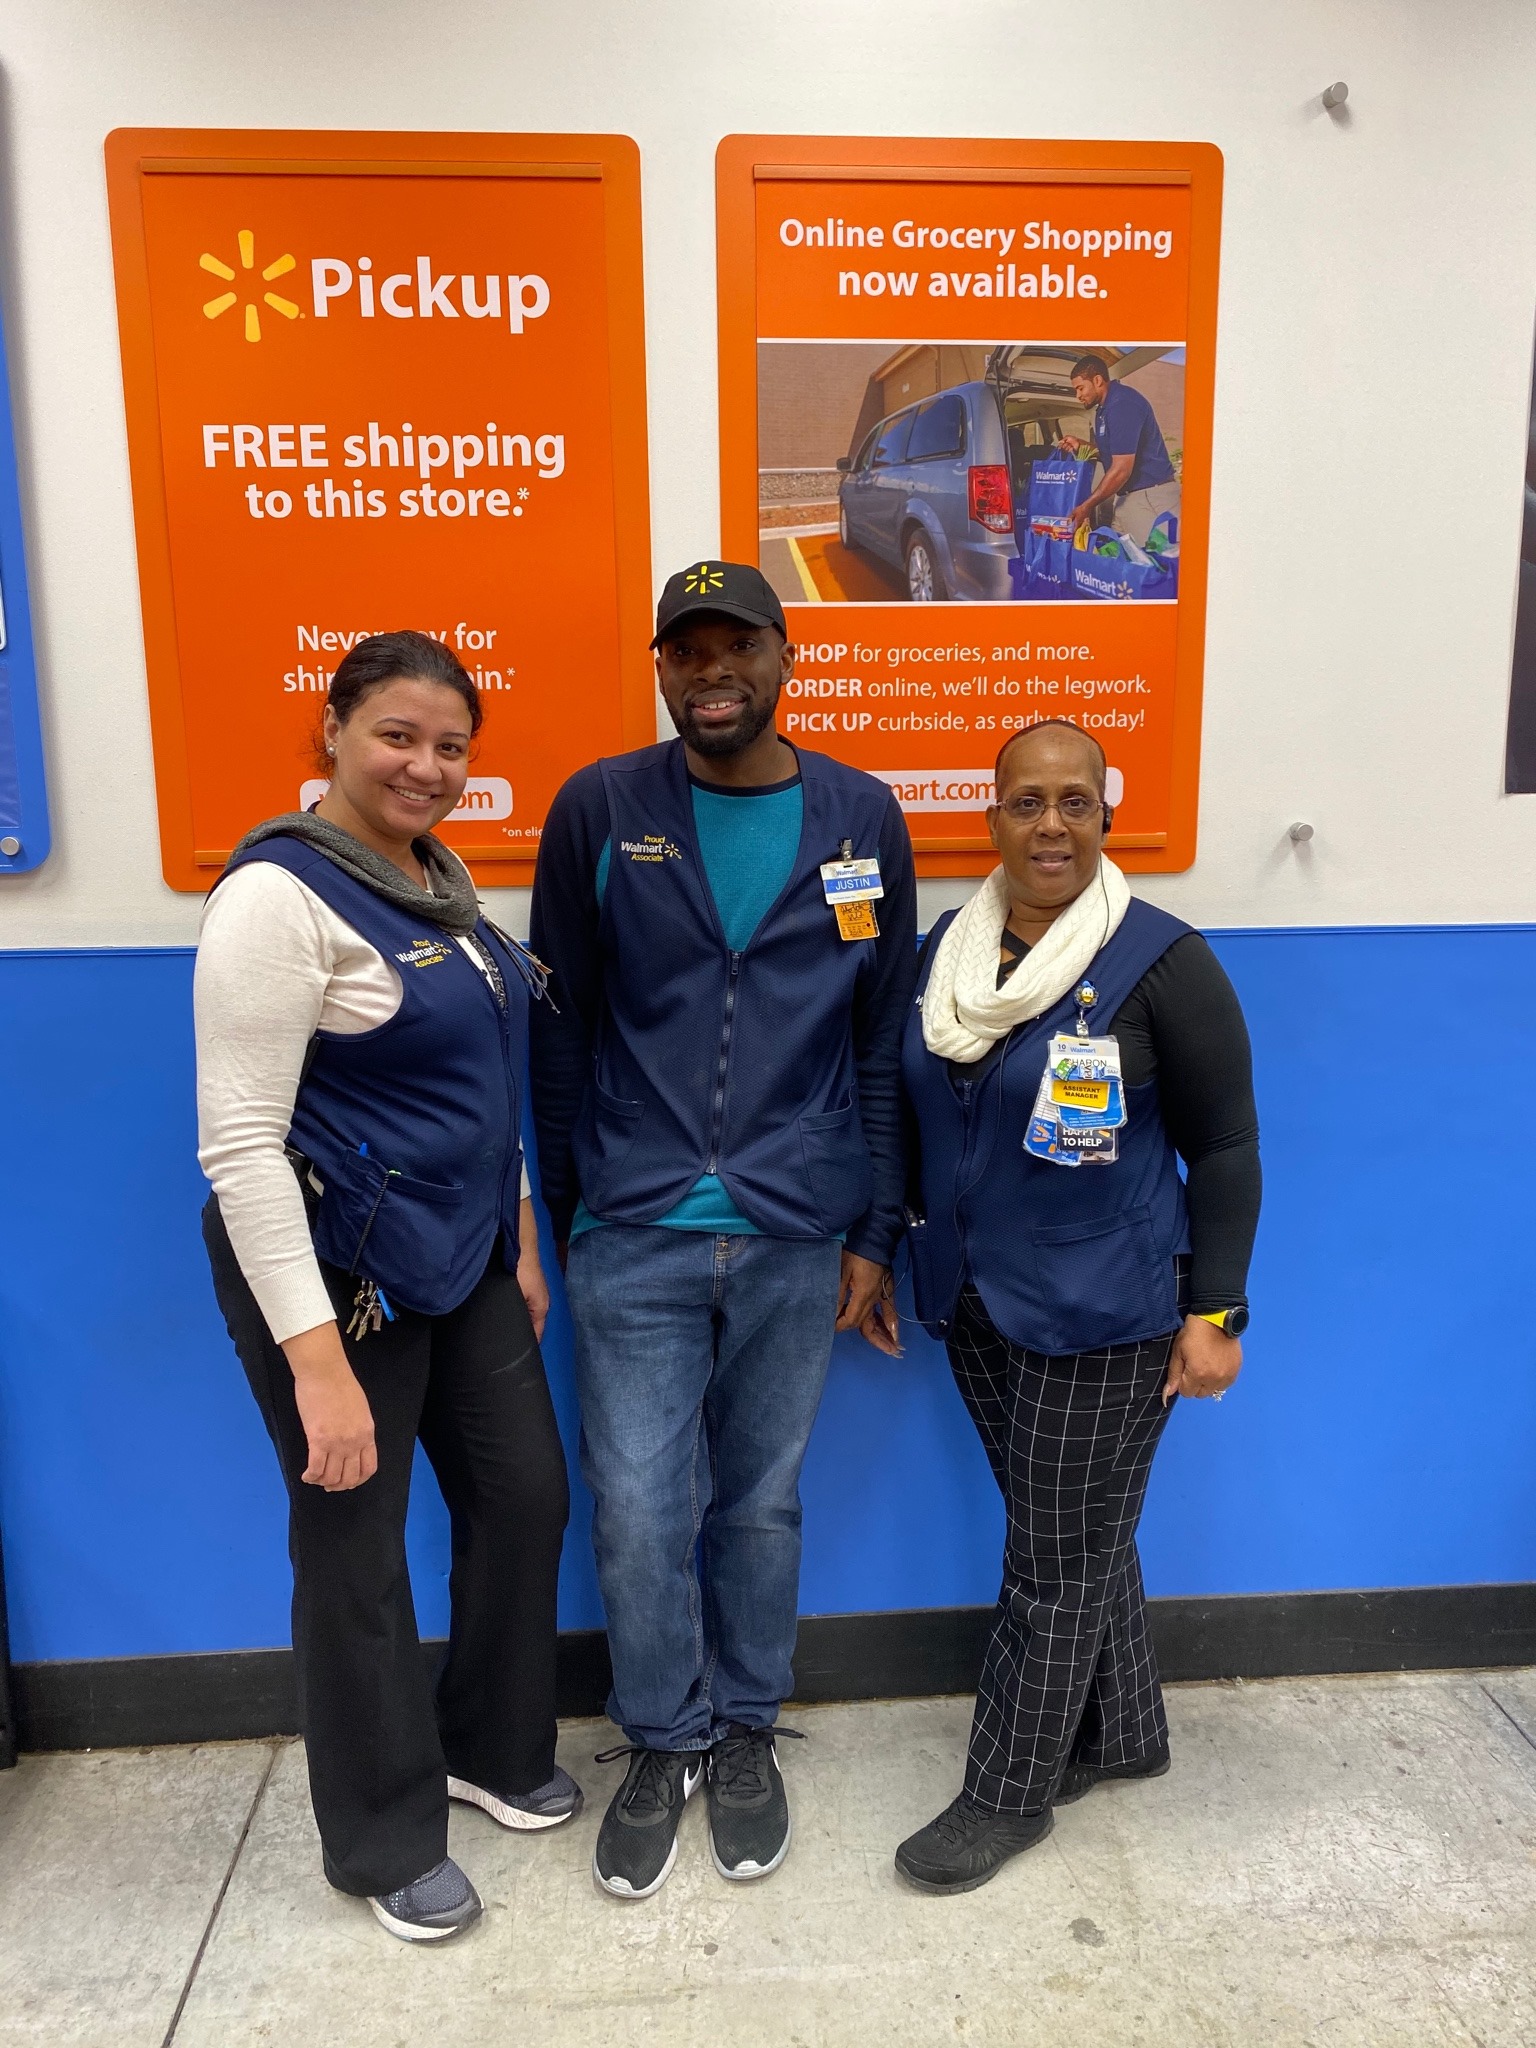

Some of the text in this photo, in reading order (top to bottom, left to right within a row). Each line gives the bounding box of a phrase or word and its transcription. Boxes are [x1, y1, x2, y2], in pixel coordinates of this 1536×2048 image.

[780, 218, 1172, 259] Online Grocery Shopping
[839, 264, 1108, 299] now available.
[311, 256, 550, 334] Pickup
[202, 422, 565, 480] FREE shipping
[1036, 471, 1065, 481] Walmart
[244, 484, 293, 519] to
[303, 479, 387, 518] this
[1075, 568, 1116, 596] Walmart
[297, 625, 385, 651] Neve
[454, 622, 497, 650] for
[853, 643, 882, 663] for
[887, 643, 986, 667] groceries,
[991, 641, 1030, 661] and
[1037, 645, 1095, 661] more.
[786, 674, 1151, 699] ORDER online, we'll do the legwork.
[786, 713, 836, 732] PICK
[842, 712, 872, 731] UP
[877, 711, 969, 733] curbside,
[975, 715, 996, 730] as
[1082, 708, 1144, 732] today!
[644, 835, 665, 844] Proud
[621, 841, 663, 854] Walmart
[631, 852, 664, 862] Associate
[836, 868, 858, 877] Walmart
[835, 877, 870, 891] JUSTIN
[412, 939, 430, 948] Proud
[395, 944, 438, 963] Walmart
[414, 955, 445, 968] Associate
[1058, 1043, 1097, 1055] 10 Walmart
[1063, 1084, 1101, 1094] ASSISTANT
[1065, 1091, 1099, 1100] MANAGER
[1063, 1128, 1094, 1136] HAPPY
[1062, 1137, 1103, 1147] TO HELP
